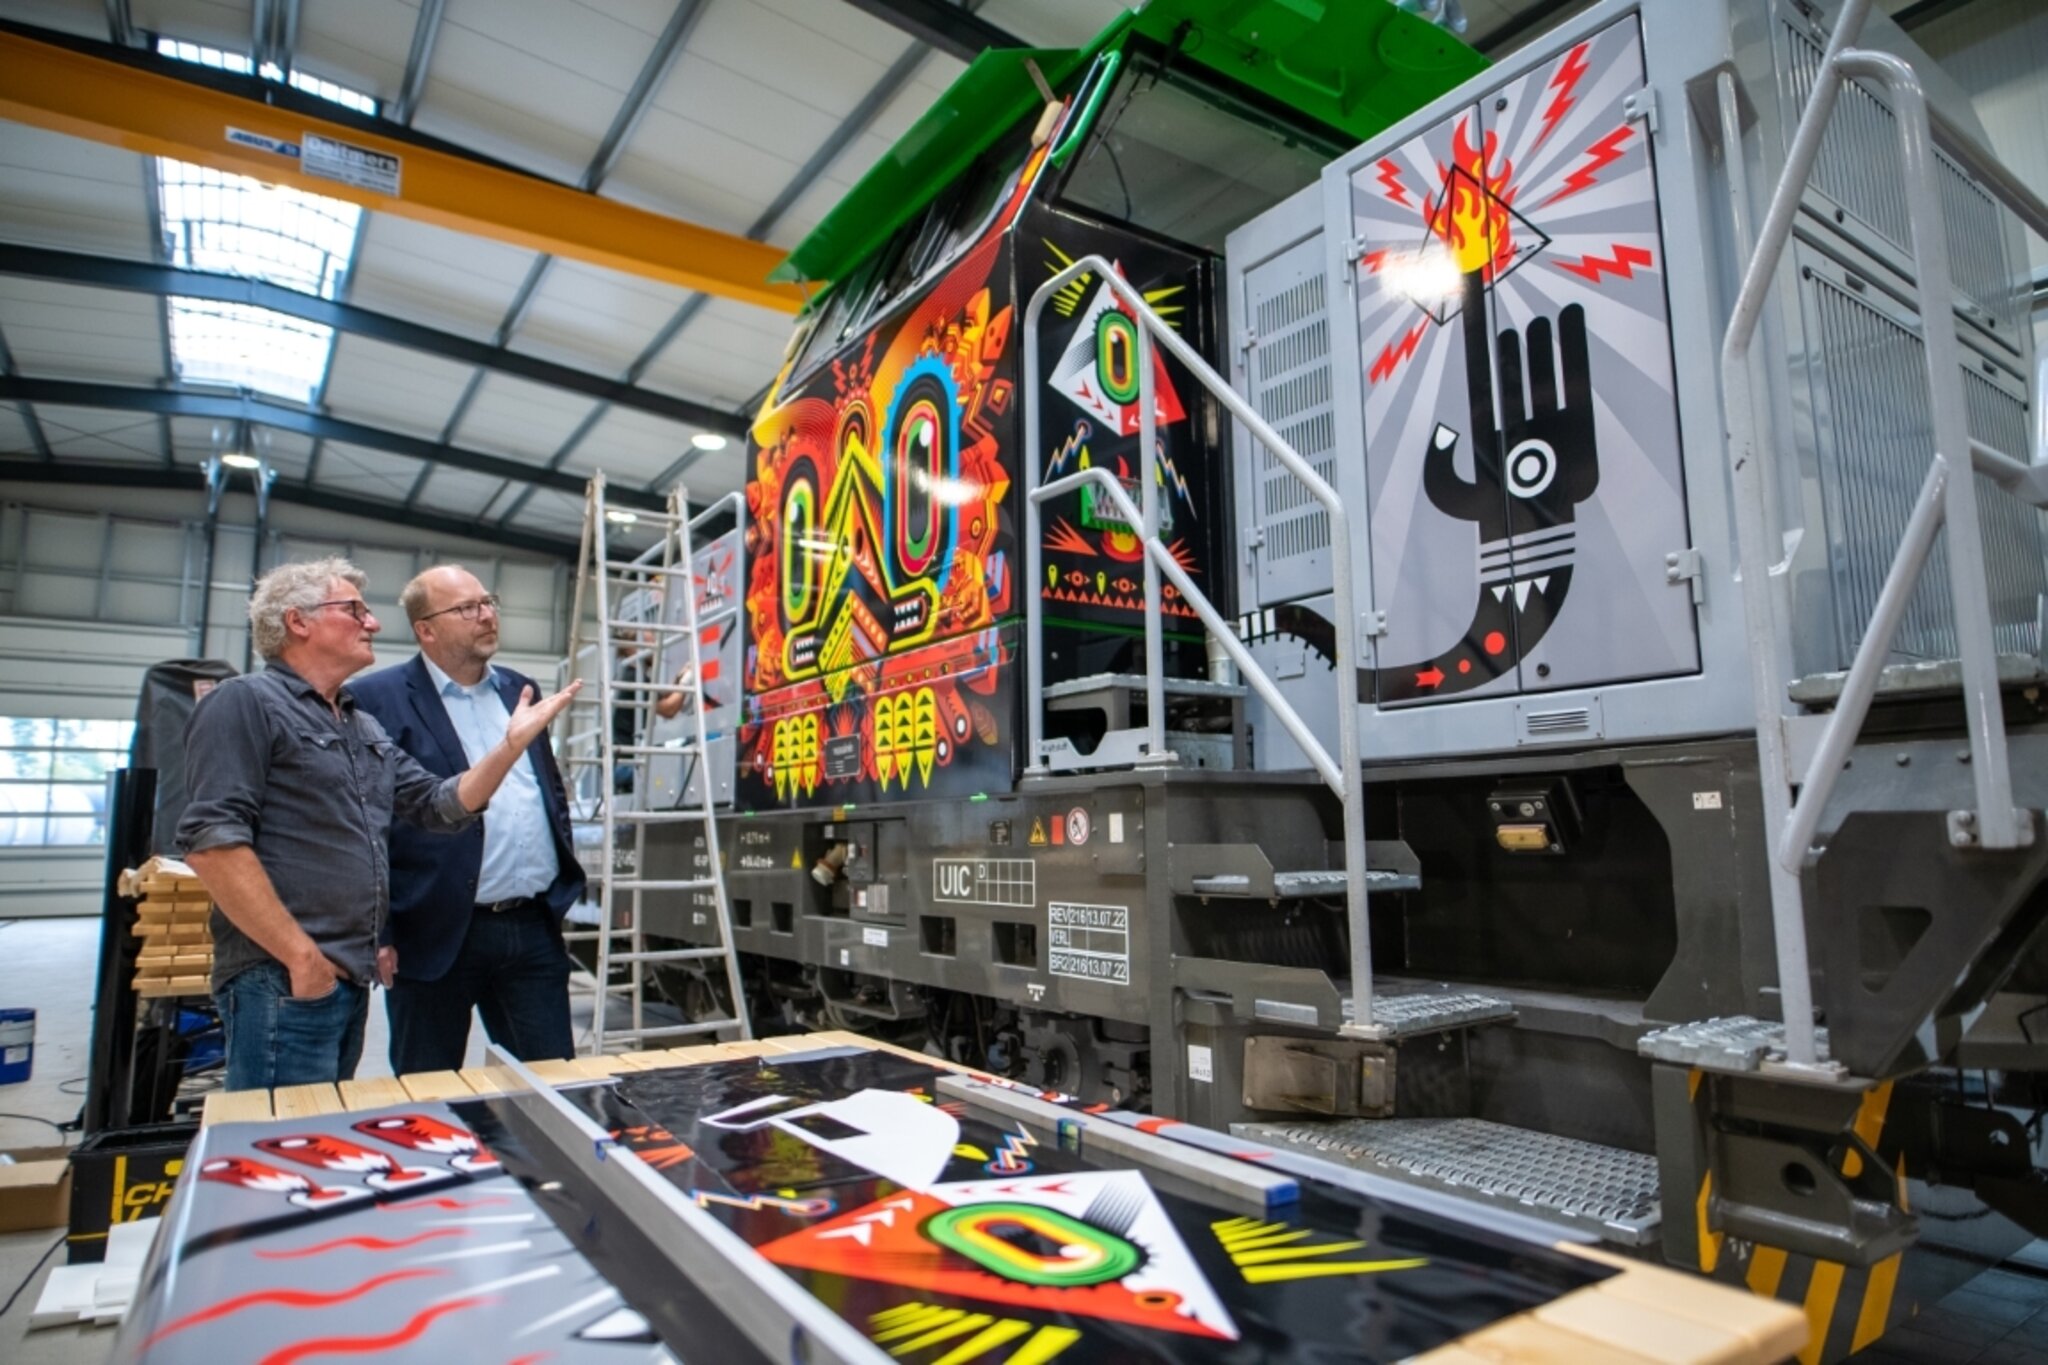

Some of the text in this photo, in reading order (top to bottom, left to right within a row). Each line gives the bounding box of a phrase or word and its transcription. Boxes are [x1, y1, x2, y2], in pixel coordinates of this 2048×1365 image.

[939, 864, 986, 897] UIC D
[1050, 907, 1069, 923] REV
[1069, 909, 1086, 925] 216
[1069, 957, 1087, 974] 216
